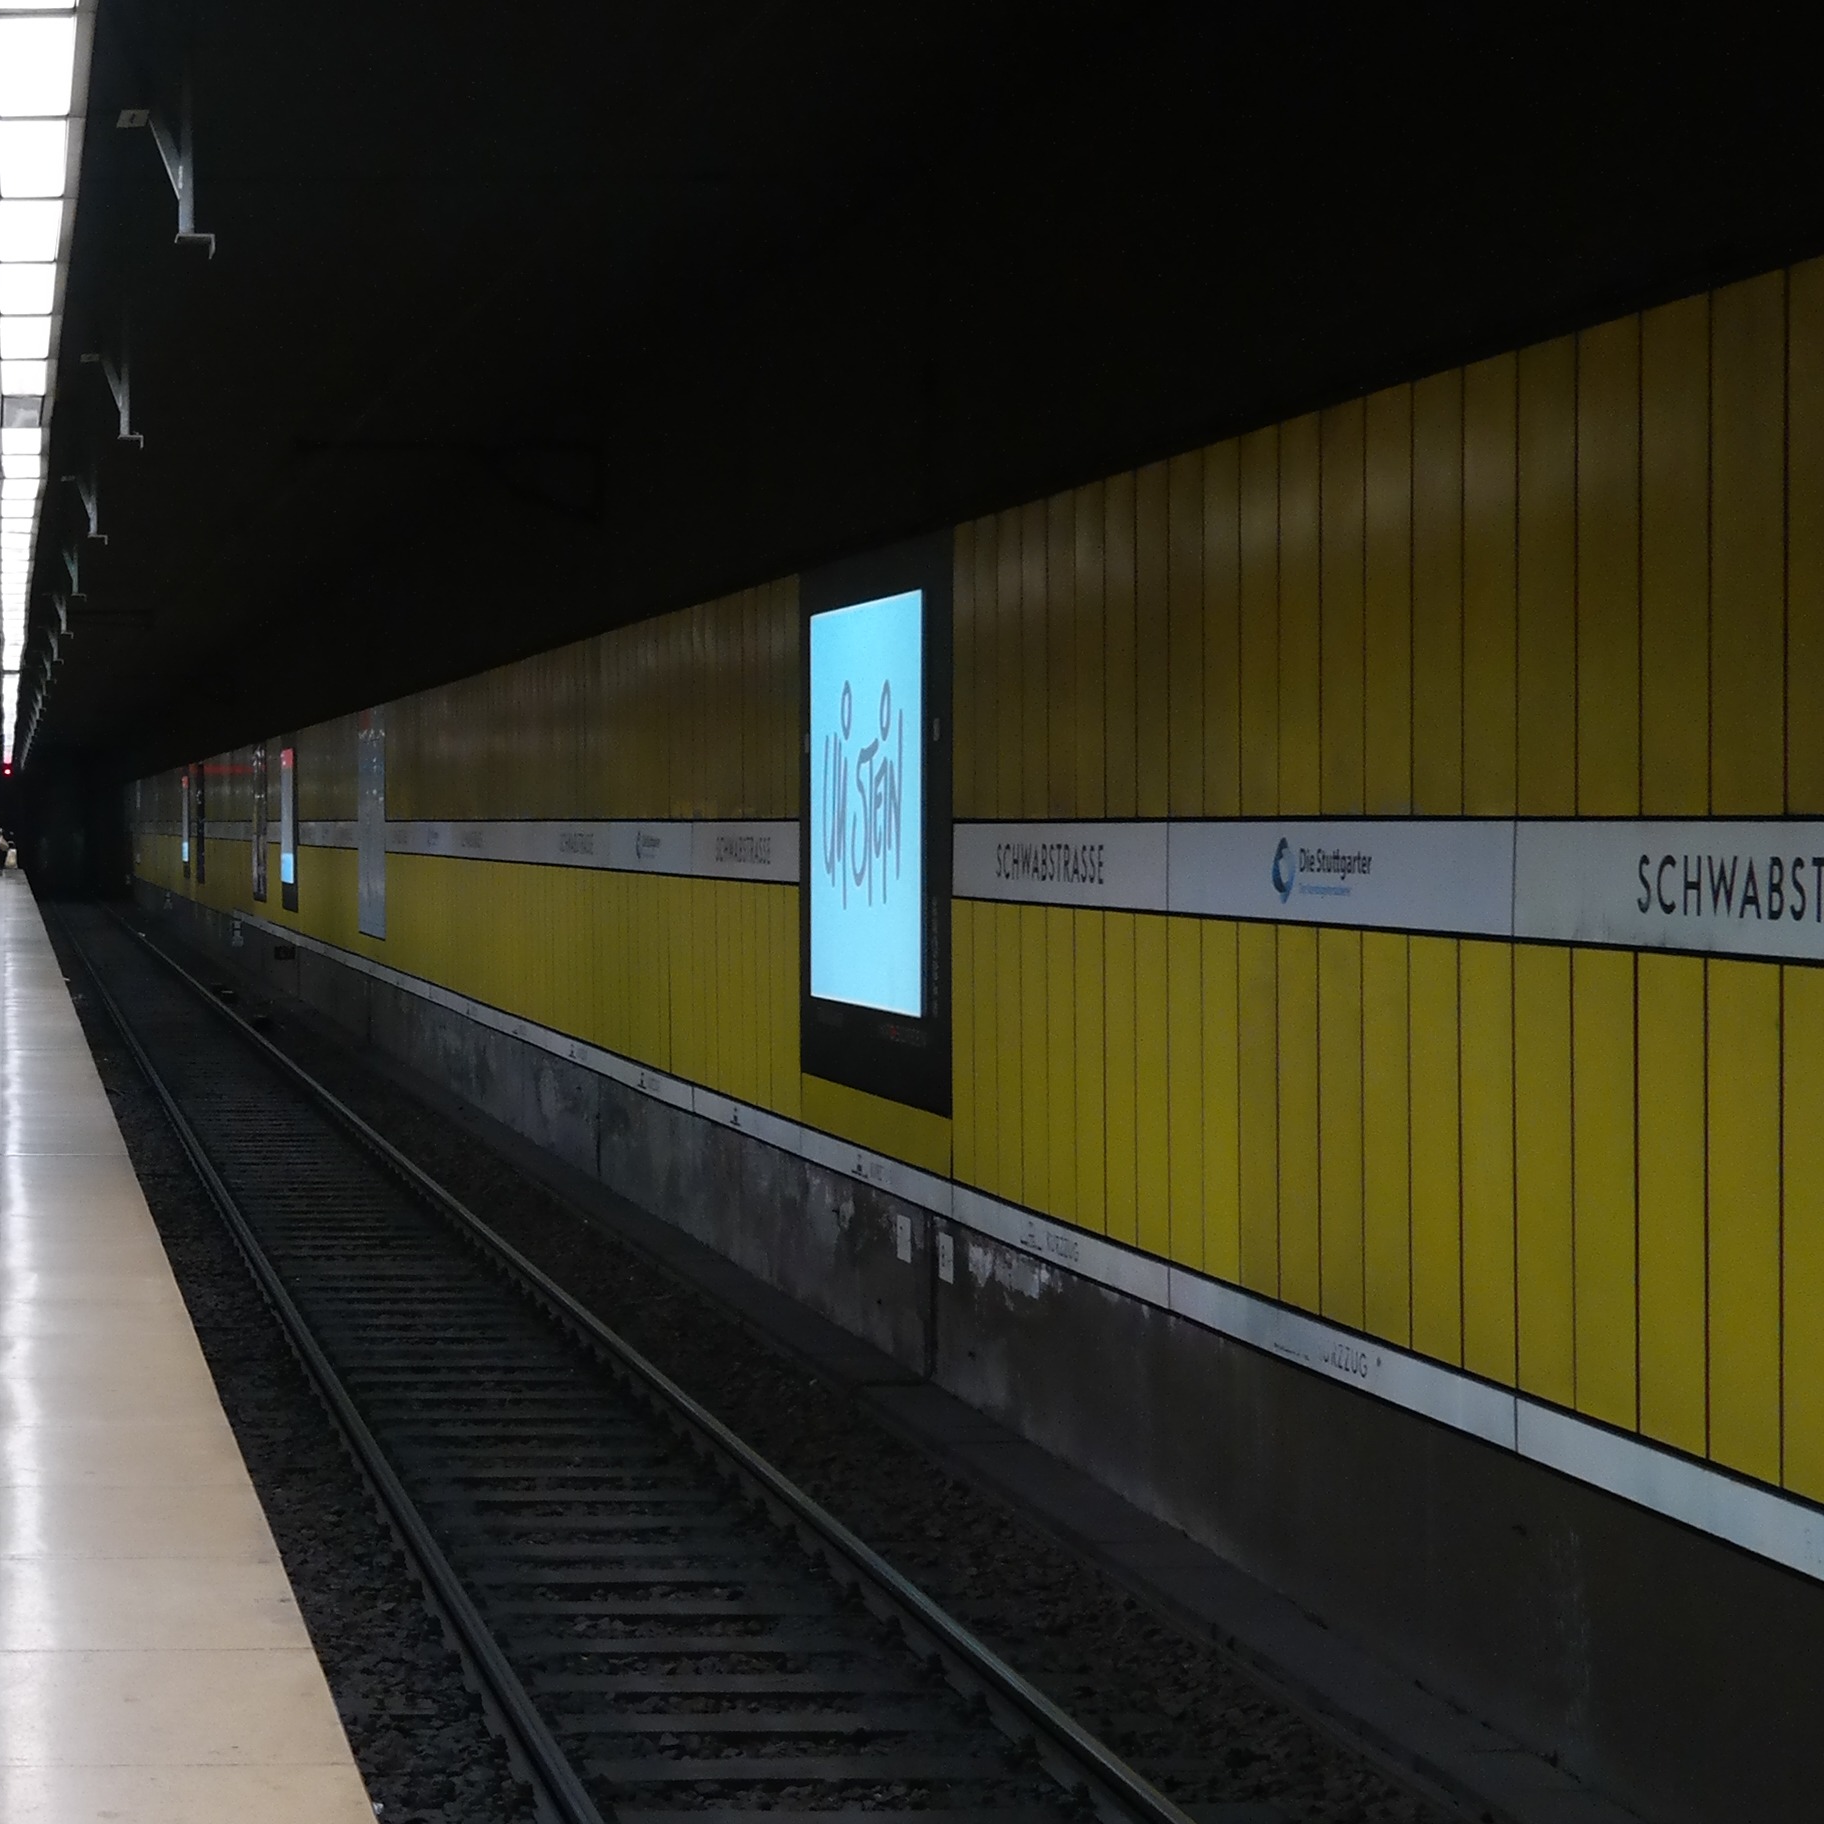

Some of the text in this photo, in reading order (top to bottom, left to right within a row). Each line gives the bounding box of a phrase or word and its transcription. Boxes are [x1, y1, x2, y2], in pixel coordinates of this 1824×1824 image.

[996, 843, 1104, 885] SCHWABSTRASSE
[1299, 848, 1372, 880] Die Stuttgarter
[1637, 854, 1824, 923] SCHWABST
